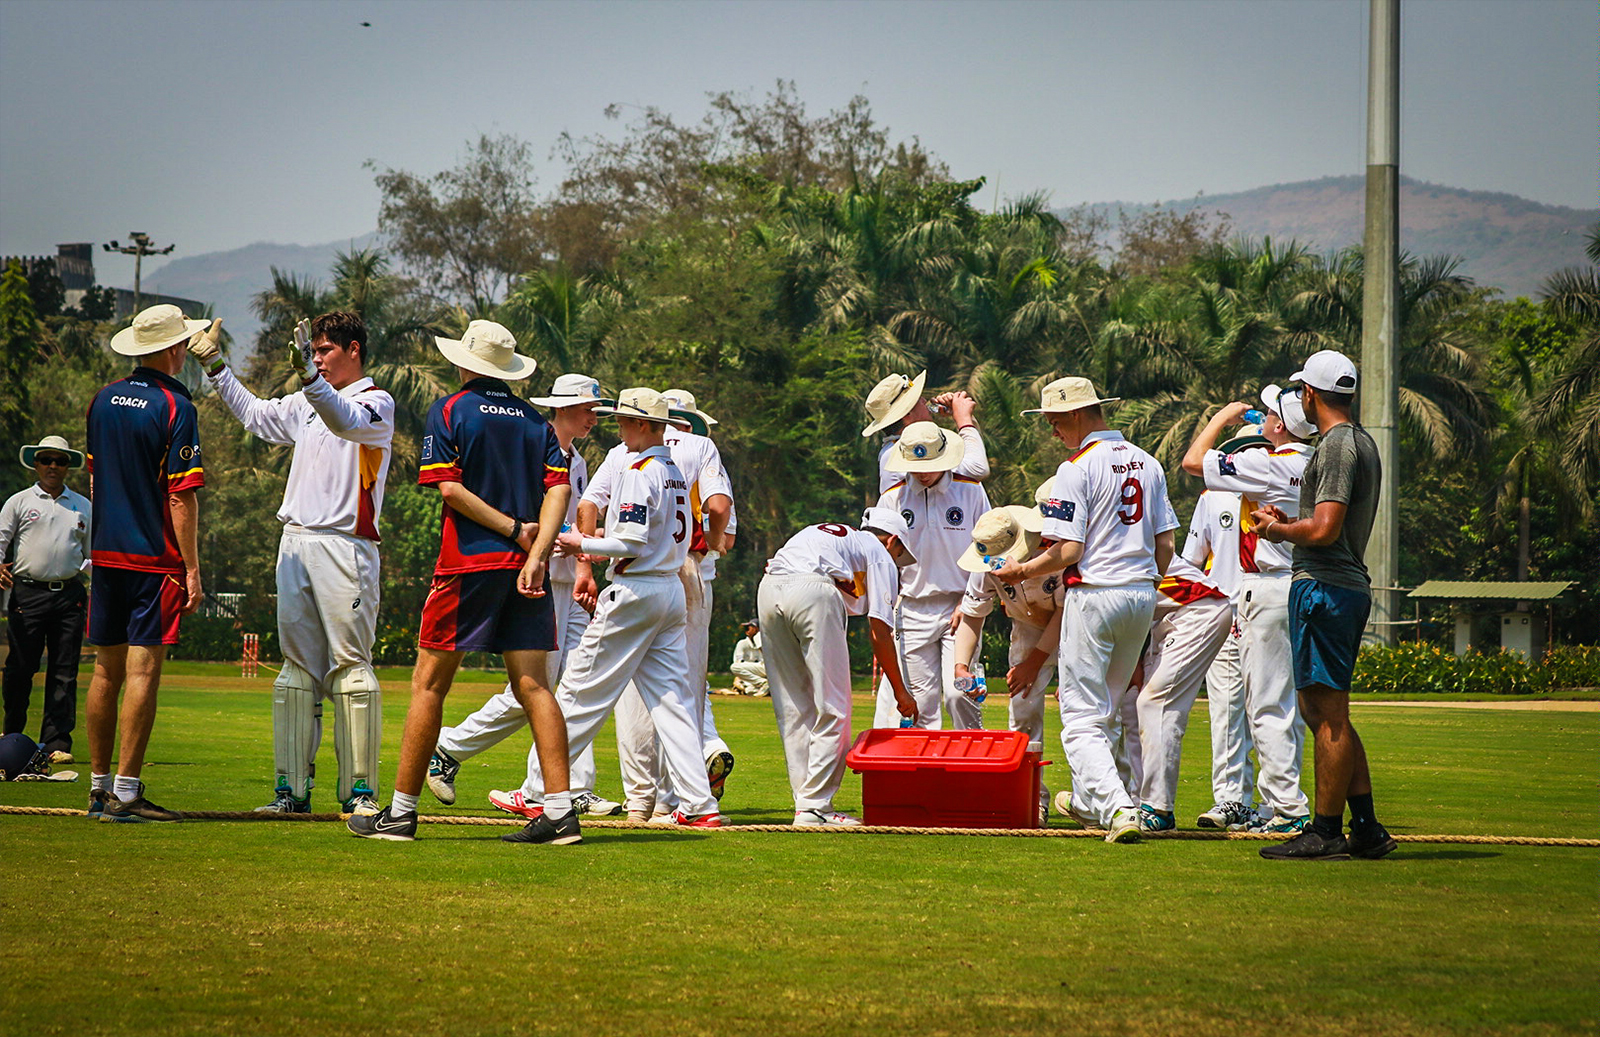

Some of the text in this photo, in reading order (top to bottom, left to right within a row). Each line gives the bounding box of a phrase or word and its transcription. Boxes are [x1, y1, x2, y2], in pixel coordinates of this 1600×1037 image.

[110, 395, 148, 409] COACH
[479, 404, 525, 418] COACH
[1111, 461, 1144, 474] RIDLEY
[1117, 477, 1144, 525] 9
[672, 495, 686, 544] 5
